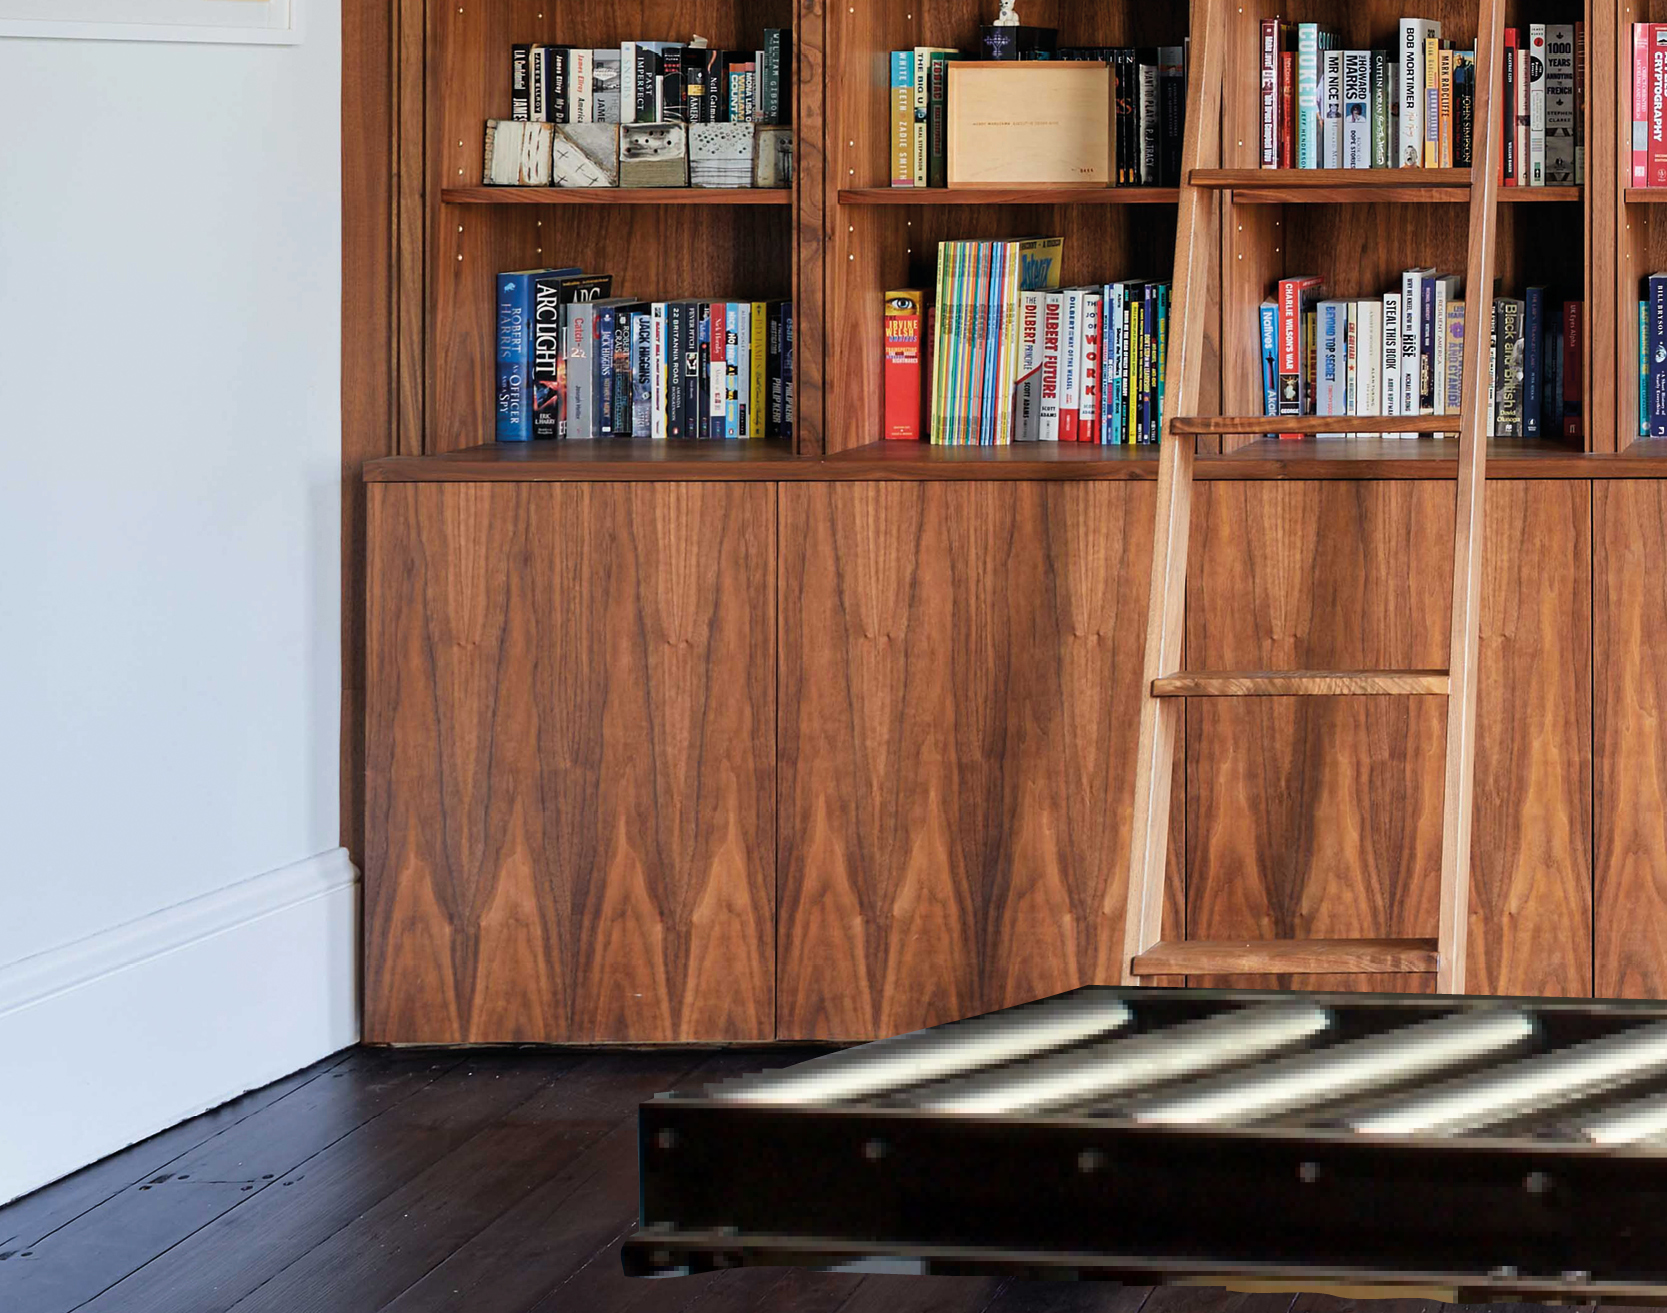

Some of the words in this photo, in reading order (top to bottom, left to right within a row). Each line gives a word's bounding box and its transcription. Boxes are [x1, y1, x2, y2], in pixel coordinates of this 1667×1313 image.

[1406, 28, 1414, 49] BOB
[1548, 44, 1571, 54] 1000
[899, 52, 907, 80] WHITE
[1329, 56, 1338, 73] MR
[1549, 59, 1570, 67] YEARS
[1328, 76, 1338, 100] NICE
[1346, 56, 1356, 99] MARKS
[1358, 60, 1366, 99] HOWARD
[1406, 52, 1414, 109] MORTIMER
[899, 84, 907, 111] TEETH
[1653, 52, 1662, 142] CRYPTOGRAPHY
[899, 122, 907, 147] ZADIE
[899, 152, 907, 180] SMITH
[890, 320, 917, 328] IRVINE
[1386, 300, 1396, 326] STEAL
[537, 285, 557, 379] ARCLIGHT
[639, 318, 650, 343] JACK
[886, 328, 913, 336] WELSH
[1046, 304, 1059, 352] DILBERT
[1386, 328, 1396, 345] THIS
[639, 346, 650, 384] HIGGINS
[1386, 349, 1396, 369] BOOK
[1043, 353, 1056, 398] FUTURE
